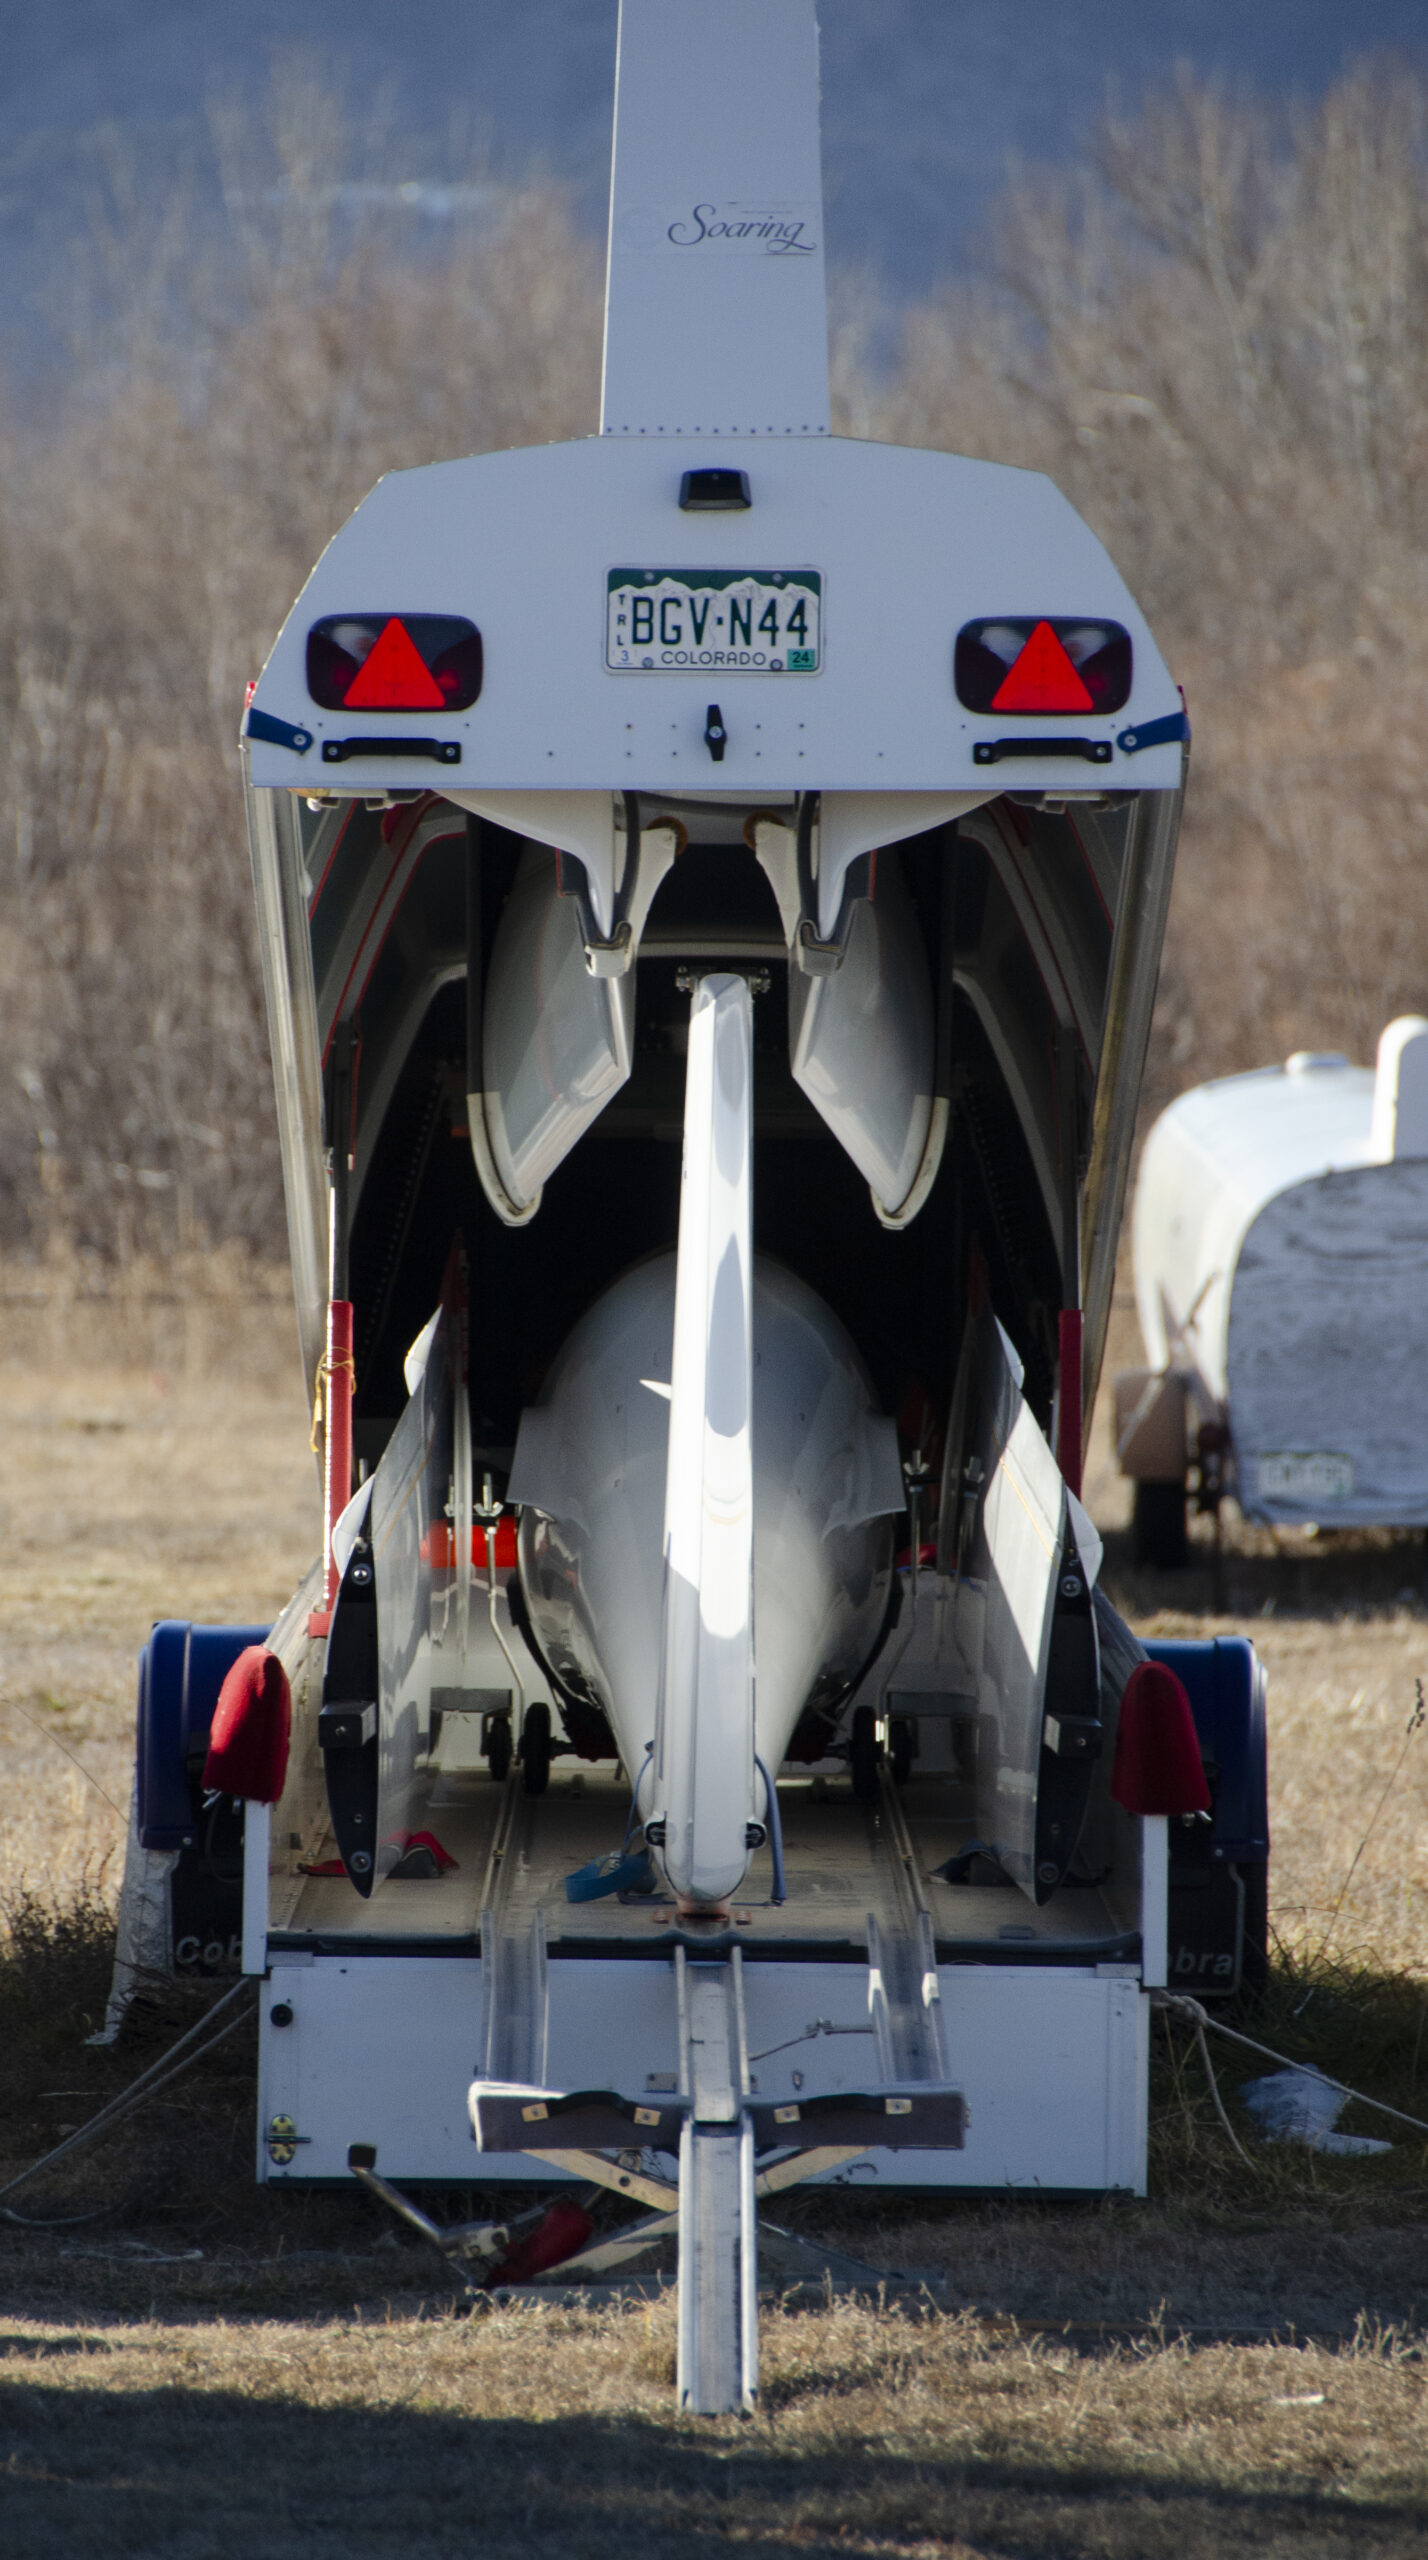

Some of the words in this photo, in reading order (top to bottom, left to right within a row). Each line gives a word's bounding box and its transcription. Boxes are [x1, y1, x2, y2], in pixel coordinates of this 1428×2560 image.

[667, 203, 817, 253] Soaring
[616, 594, 628, 646] TRL
[620, 649, 630, 662] 3
[660, 650, 767, 666] COLORADO
[791, 651, 810, 663] 24
[176, 1935, 242, 1963] Cob
[1168, 1946, 1233, 1975] bra
